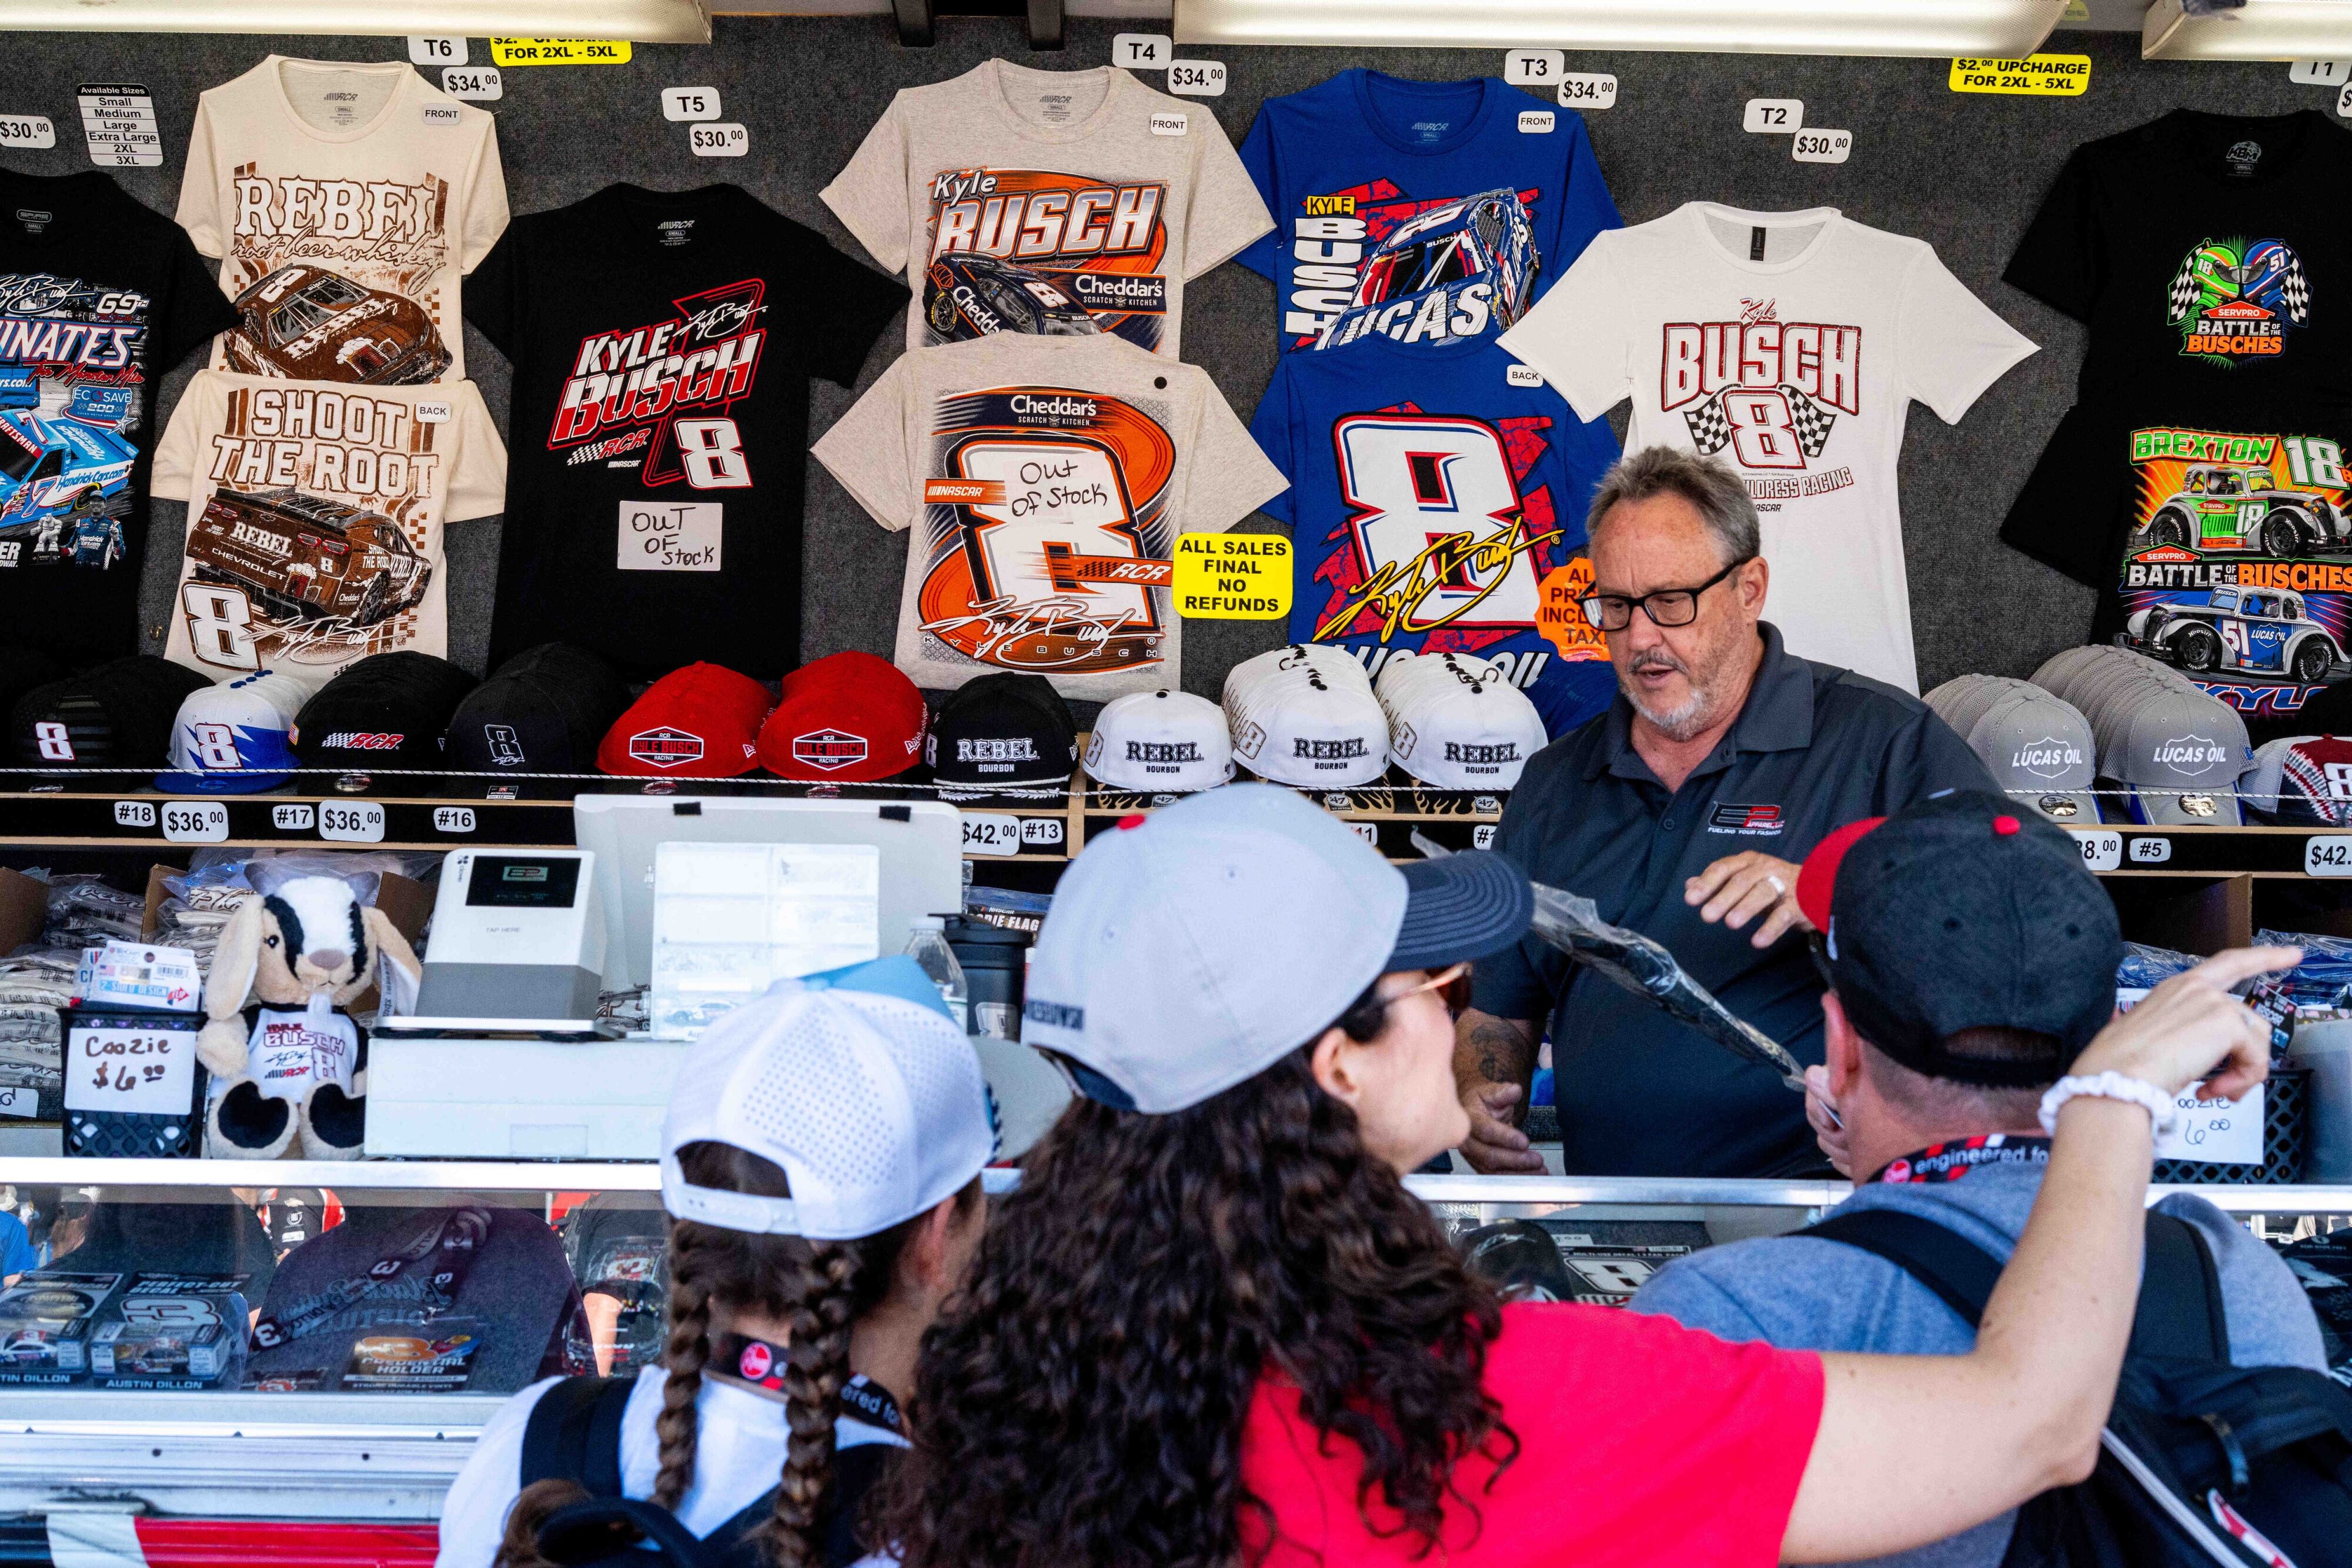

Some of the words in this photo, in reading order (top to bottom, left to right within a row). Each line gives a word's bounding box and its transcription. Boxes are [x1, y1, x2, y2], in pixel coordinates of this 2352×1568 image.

[423, 39, 452, 56] T6
[505, 48, 538, 59] FOR
[542, 46, 574, 58] 2XL
[587, 46, 618, 57] 5XL
[1128, 42, 1155, 61] T4
[1173, 66, 1224, 86] $34.00
[1521, 59, 1548, 76] T3
[1997, 60, 2088, 75] UPCHARGE
[448, 75, 498, 92] $34.00
[1563, 81, 1614, 100] $34.00
[1963, 74, 1996, 86] FOR
[2000, 75, 2032, 88] 2XL
[2044, 76, 2075, 89] 5XL
[99, 98, 131, 106] Small
[677, 96, 705, 113] T5
[94, 109, 141, 118] Medium
[425, 109, 458, 118] FRONT
[1521, 117, 1553, 126] FRONT
[1760, 108, 1787, 125] T2
[0, 121, 49, 139] $30.00
[103, 121, 137, 132] Large
[1152, 119, 1185, 130] FRONT
[89, 132, 119, 141] Extra
[123, 133, 156, 143] Large
[694, 130, 743, 149] $30.00
[1797, 135, 1847, 155] $30.00
[113, 144, 137, 153] 2XL
[116, 156, 139, 165] 3XL
[933, 169, 998, 208] Kyle
[233, 174, 436, 245] REBEL
[1309, 196, 1352, 215] KYLE
[928, 186, 1164, 270] BUSCH
[1426, 236, 1457, 249] BUSCH
[2197, 258, 2213, 276] 18
[2270, 252, 2286, 273] 51
[1285, 217, 1367, 335] BUSCH
[1075, 275, 1163, 297] Cheddar's
[1083, 296, 1113, 304] SCRATCH
[1740, 297, 1777, 325] Kyle
[2218, 309, 2260, 317] SERVPRO
[2196, 320, 2270, 336] BATTLE
[576, 322, 676, 377] KYLE
[2186, 335, 2283, 354] BUSCHES
[1512, 372, 1539, 380] BACK
[1662, 322, 1862, 415] BUSCH
[550, 332, 762, 444] BUSCH
[87, 403, 115, 413] 200
[420, 406, 447, 416] BACK
[1010, 395, 1097, 416] Cheddar's
[14, 411, 49, 445] 7
[250, 389, 408, 450] SHOOT
[1018, 416, 1047, 424] SCRATCH
[1062, 417, 1090, 426] KITCHEN
[1722, 390, 1807, 470] 8
[674, 416, 753, 489] 8
[2133, 431, 2277, 465] BREXTON
[208, 434, 303, 488] THE
[309, 442, 440, 499] ROOT
[1020, 459, 1078, 484] Out
[2283, 436, 2350, 490] 18
[1800, 467, 1855, 496] RACING
[21, 478, 57, 519] 7
[940, 486, 985, 497] NASCAR
[1332, 413, 1539, 628] 8
[2234, 503, 2267, 534] 18
[230, 521, 293, 557] REBEL
[644, 533, 680, 554] OF
[1180, 539, 1217, 554] ALL
[1224, 541, 1287, 556] SALES
[212, 547, 286, 580] CHEVROLET
[320, 557, 333, 573] 8
[362, 556, 375, 569] THE
[2147, 552, 2187, 561] SERVPRO
[1108, 563, 1172, 580] RCR
[1204, 559, 1262, 574] FINAL
[1218, 579, 1247, 593] NO
[2127, 564, 2224, 587] BATTLE
[2226, 565, 2237, 574] OF
[2238, 563, 2352, 591] BUSCHES
[2224, 574, 2238, 584] THE
[339, 593, 360, 602] Cheddar's
[1185, 596, 1279, 612] REFUNDS
[181, 581, 263, 672] 8
[2250, 628, 2275, 640] LUCAS
[2276, 631, 2287, 641] OIL
[2221, 618, 2251, 657] 51
[35, 721, 76, 761] 8
[195, 722, 238, 769] 8
[348, 733, 399, 750] RCR
[485, 724, 524, 760] 8
[632, 741, 659, 753] KYLE
[661, 743, 700, 754] BUSCH
[796, 743, 824, 755] KYLE
[826, 744, 864, 756] BUSCH
[957, 738, 1038, 762] REBEL
[1084, 730, 1104, 768] 8
[1237, 722, 1266, 760] 8
[1293, 737, 1367, 760] REBEL
[1125, 741, 1202, 763] REBEL
[1445, 741, 1520, 764] REBEL
[2012, 751, 2062, 767] LUCAS
[2063, 749, 2082, 765] OIL
[2153, 747, 2204, 764] LUCAS
[2207, 747, 2227, 763] OIL
[978, 764, 1015, 773] BOURBON
[1465, 766, 1499, 774] BOURBON
[119, 804, 152, 822] #18
[168, 811, 223, 834] $36.00
[276, 808, 310, 824] #17
[324, 809, 382, 833] $36.00
[437, 811, 472, 827] #16
[1025, 823, 1058, 839] #13
[2139, 843, 2162, 857] #5
[1007, 916, 1040, 932] FLAG
[85, 1036, 172, 1058] Coozie
[264, 1031, 346, 1056] BUSCH
[1915, 1148, 2026, 1174] engineered
[23, 1374, 70, 1383] DILLON
[376, 1365, 445, 1374] HOLDER
[106, 1379, 151, 1389] AUSTIN
[156, 1380, 203, 1389] DILLON
